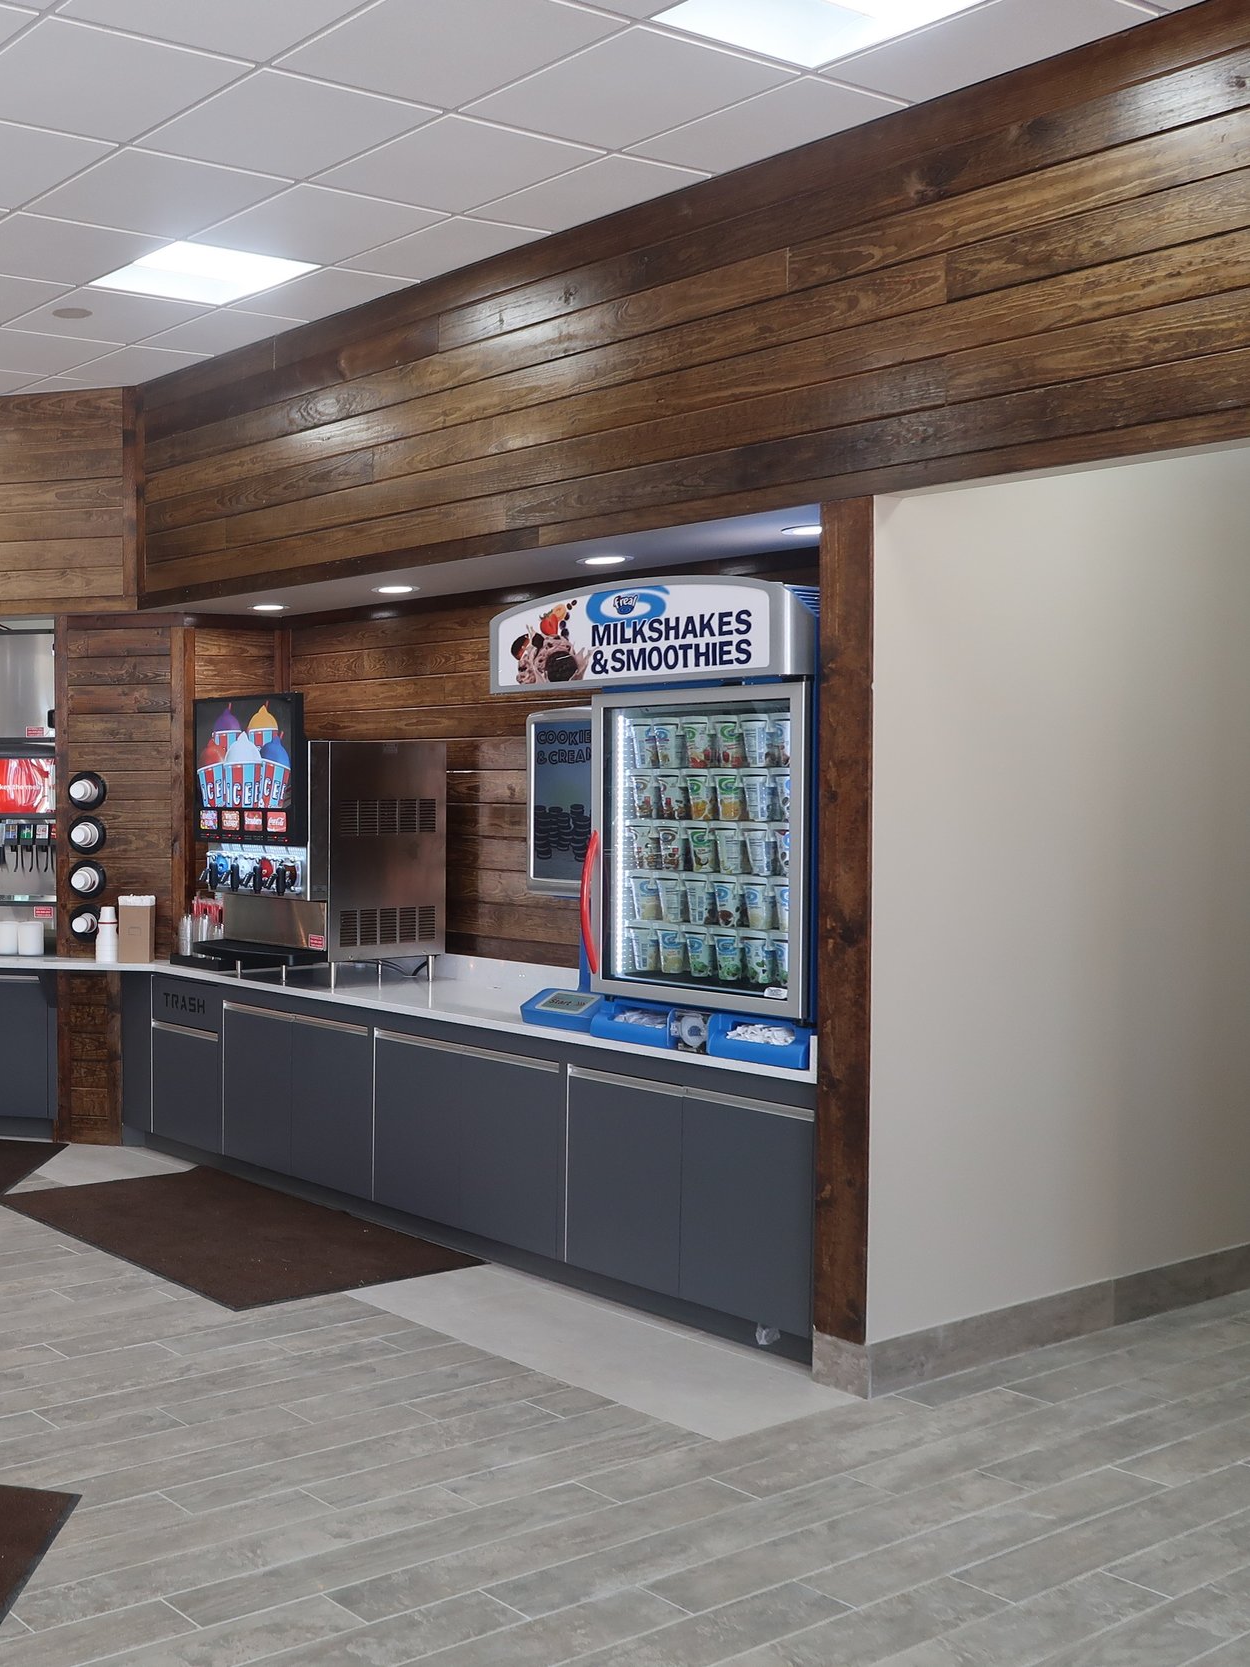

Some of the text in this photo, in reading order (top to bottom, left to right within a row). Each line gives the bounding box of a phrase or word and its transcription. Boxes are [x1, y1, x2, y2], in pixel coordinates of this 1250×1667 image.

[591, 609, 752, 647] MILKSHAKES
[537, 750, 548, 765] &
[163, 992, 206, 1014] TRASH
[549, 998, 572, 1006] Start
